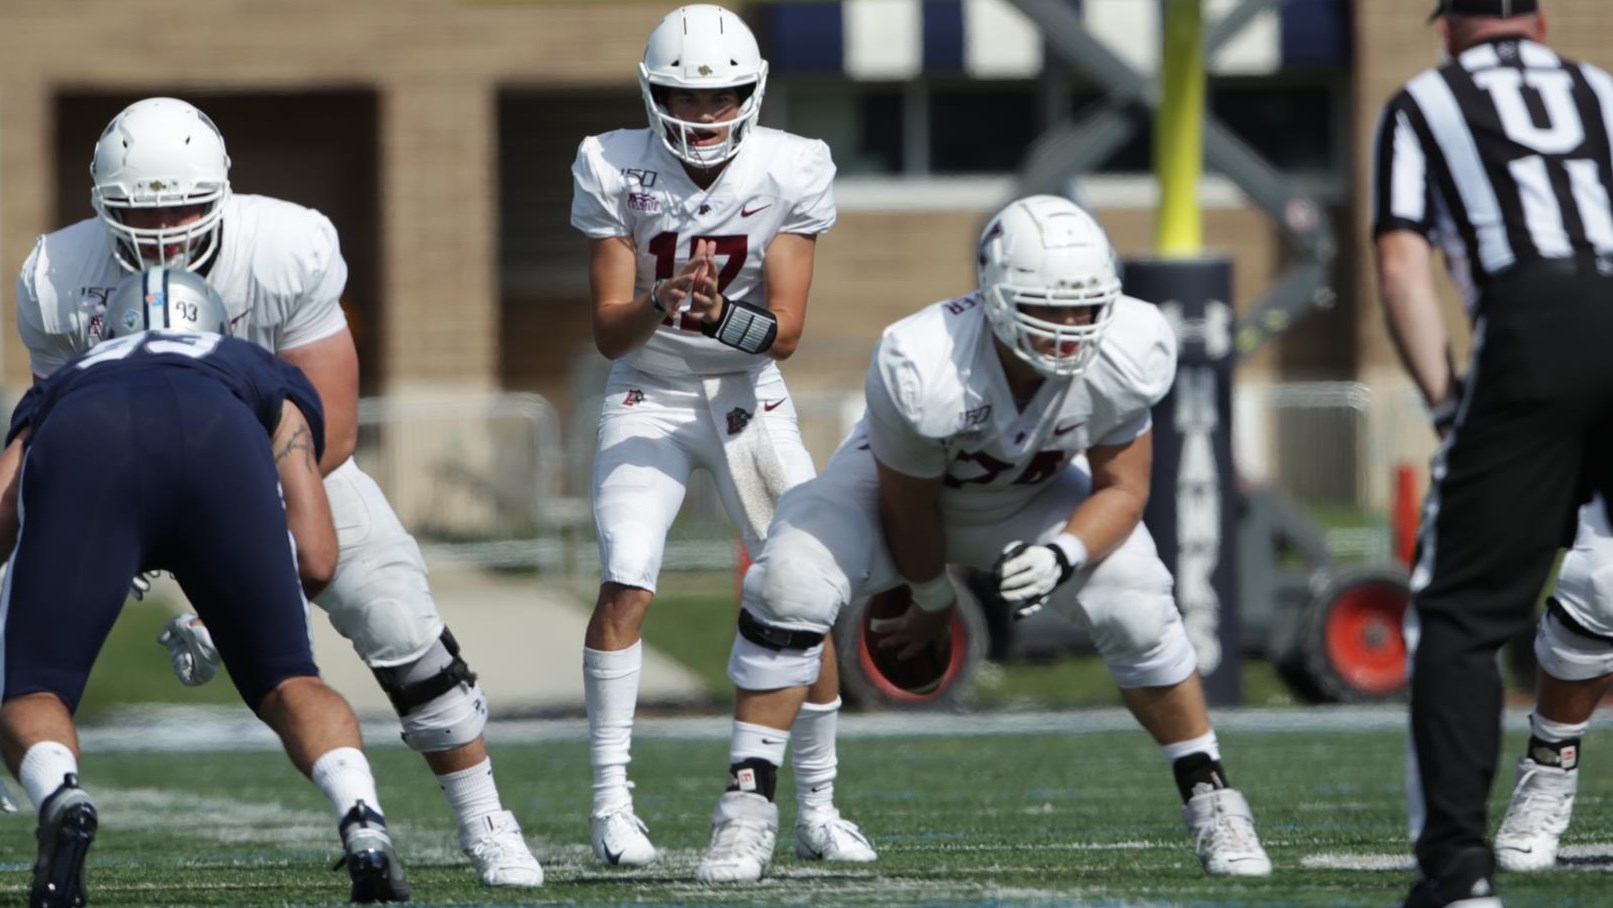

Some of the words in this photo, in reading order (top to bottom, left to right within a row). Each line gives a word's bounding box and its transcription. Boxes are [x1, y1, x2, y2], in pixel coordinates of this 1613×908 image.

[1473, 66, 1586, 155] U
[621, 168, 657, 187] 150
[648, 231, 748, 332] 17
[175, 301, 198, 322] 93
